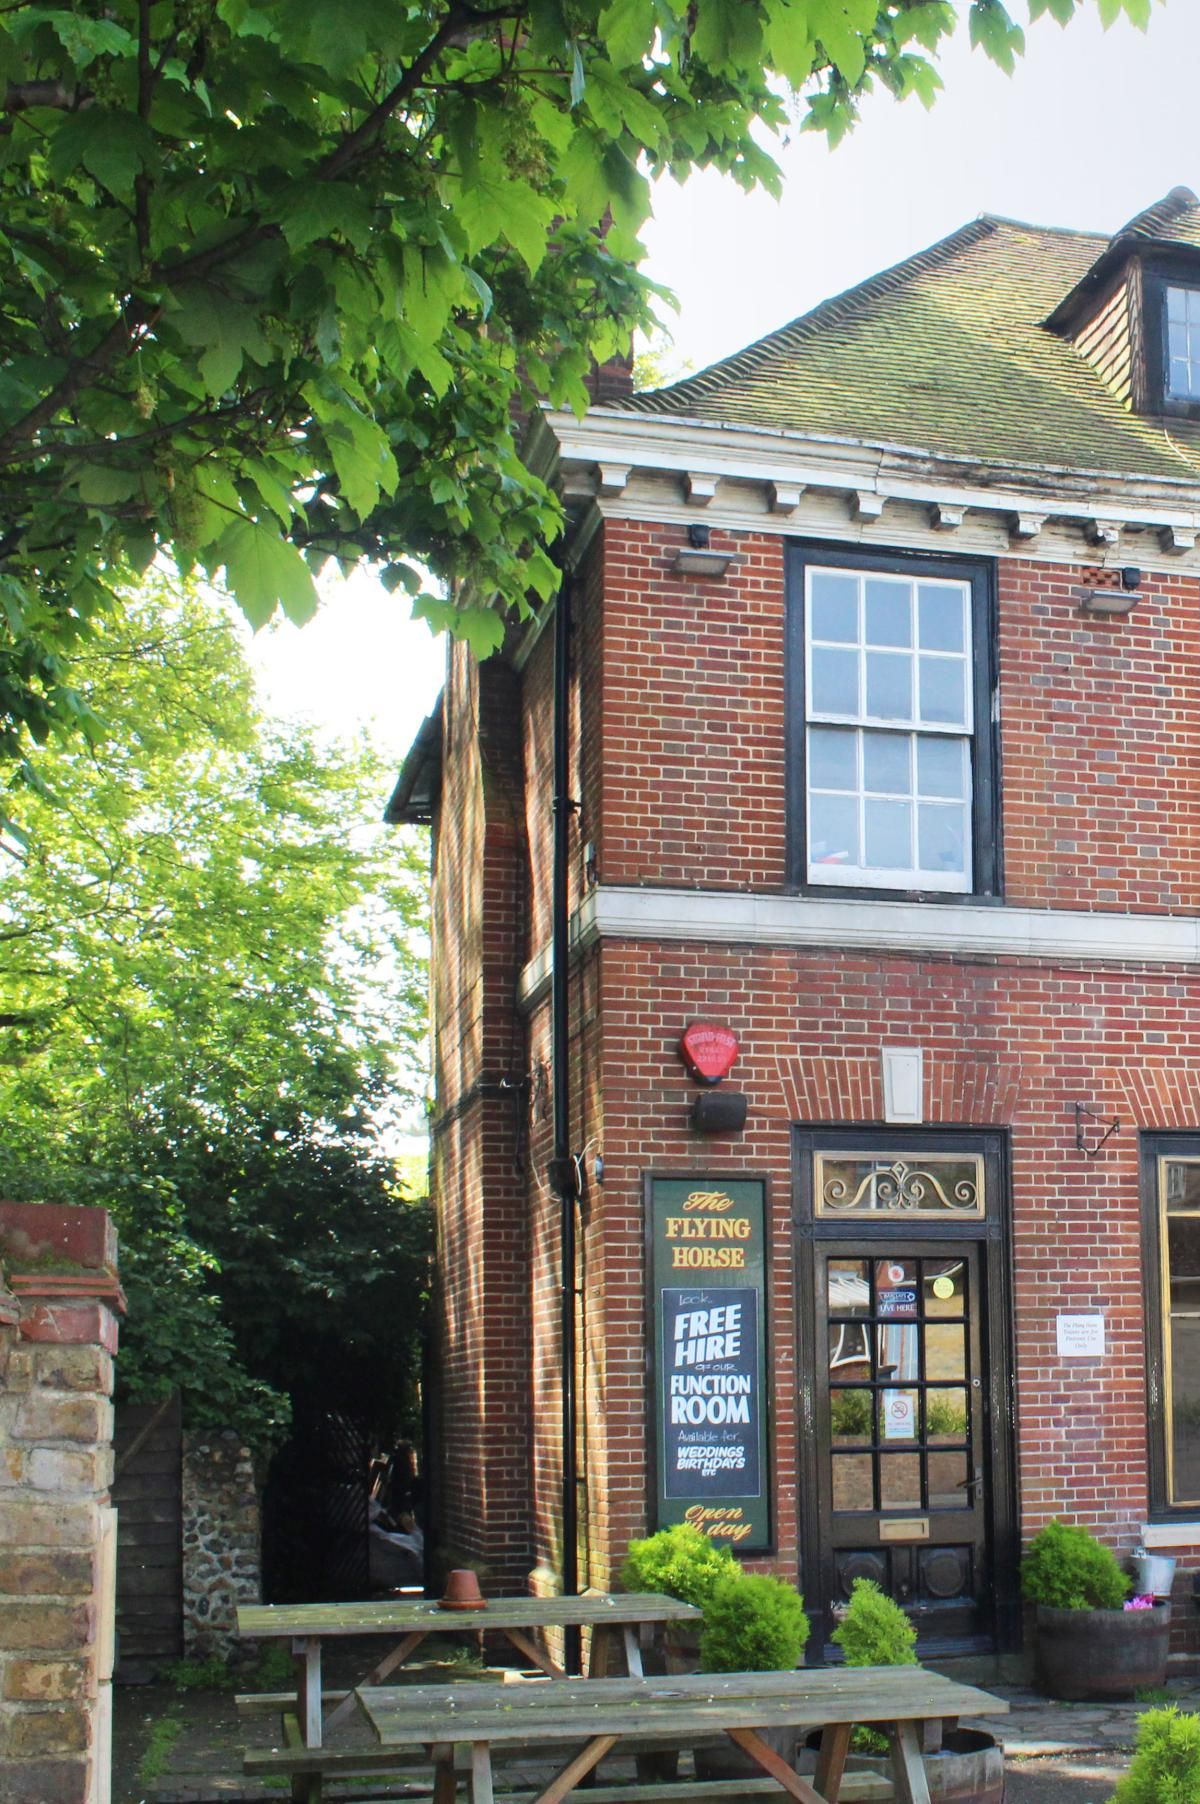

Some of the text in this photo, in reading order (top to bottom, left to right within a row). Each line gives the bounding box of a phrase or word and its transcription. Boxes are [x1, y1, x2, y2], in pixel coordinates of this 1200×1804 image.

[682, 1191, 735, 1212] The
[665, 1217, 752, 1240] FLYING
[671, 1246, 746, 1270] HORSE
[673, 1303, 742, 1341] FREE
[674, 1331, 742, 1368] HIRE
[671, 1374, 751, 1395] FUNCTION
[671, 1395, 750, 1425] ROOM
[678, 1446, 745, 1459] WEDDINGS
[677, 1457, 746, 1470] BIRTHDAYS
[684, 1504, 744, 1522] Open
[706, 1520, 752, 1541] day
